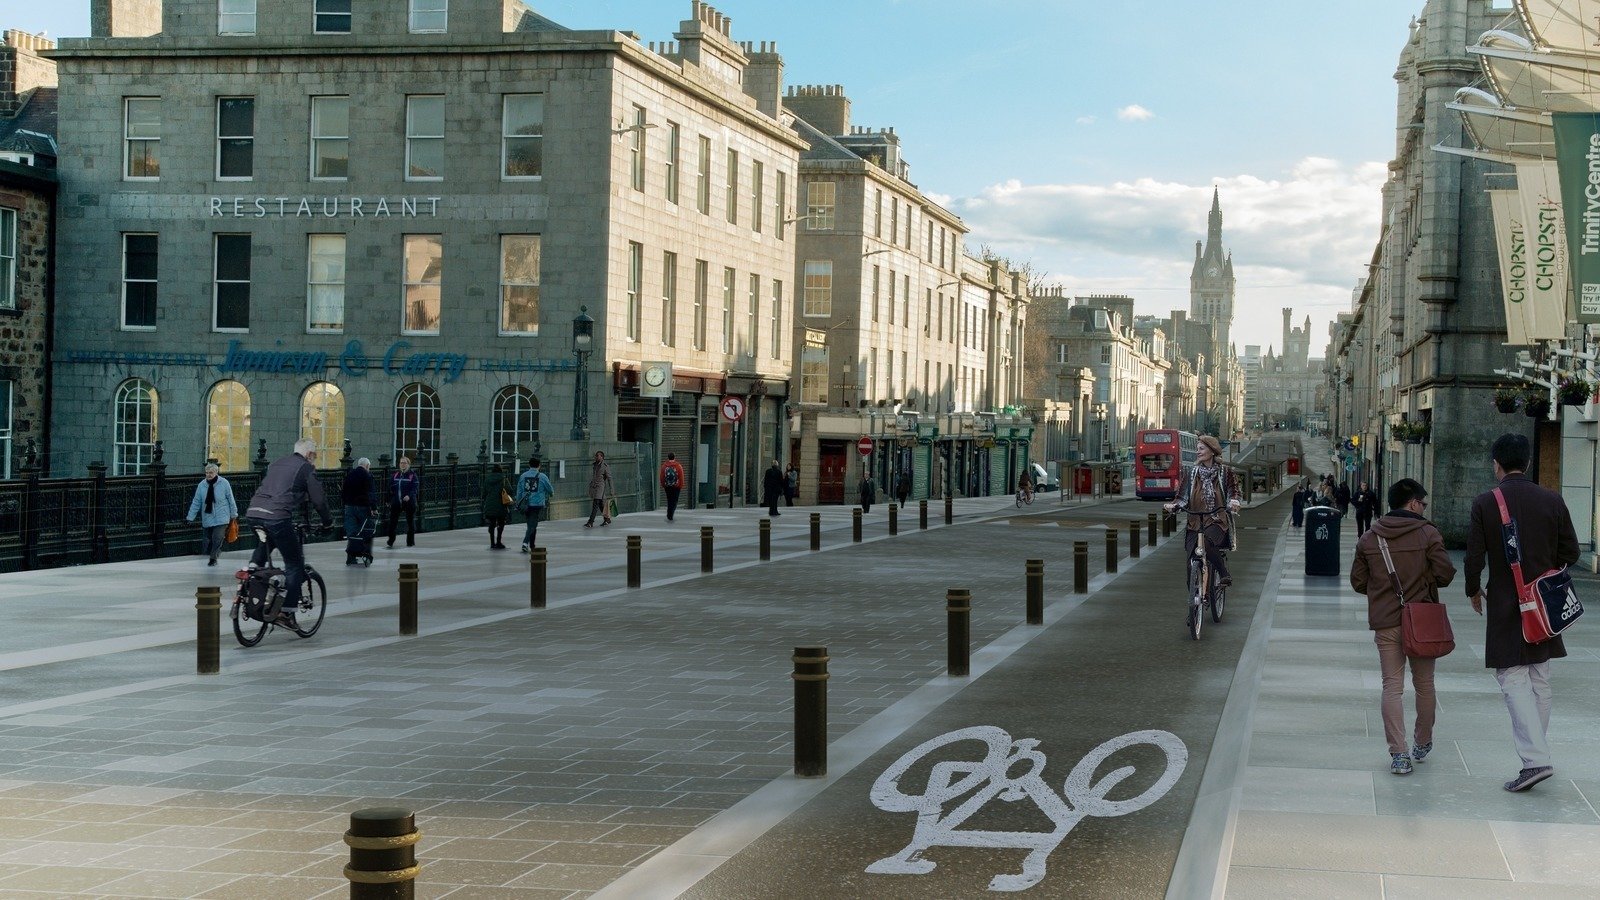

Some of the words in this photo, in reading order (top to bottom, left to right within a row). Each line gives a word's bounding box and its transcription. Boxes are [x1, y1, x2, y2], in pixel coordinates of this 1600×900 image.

[210, 197, 441, 218] RESTAURANT
[1583, 285, 1598, 293] spy
[1583, 295, 1594, 303] try
[1582, 305, 1598, 313] buy
[217, 339, 328, 374] Jamieson
[340, 339, 368, 377] &
[383, 340, 468, 385] Carry
